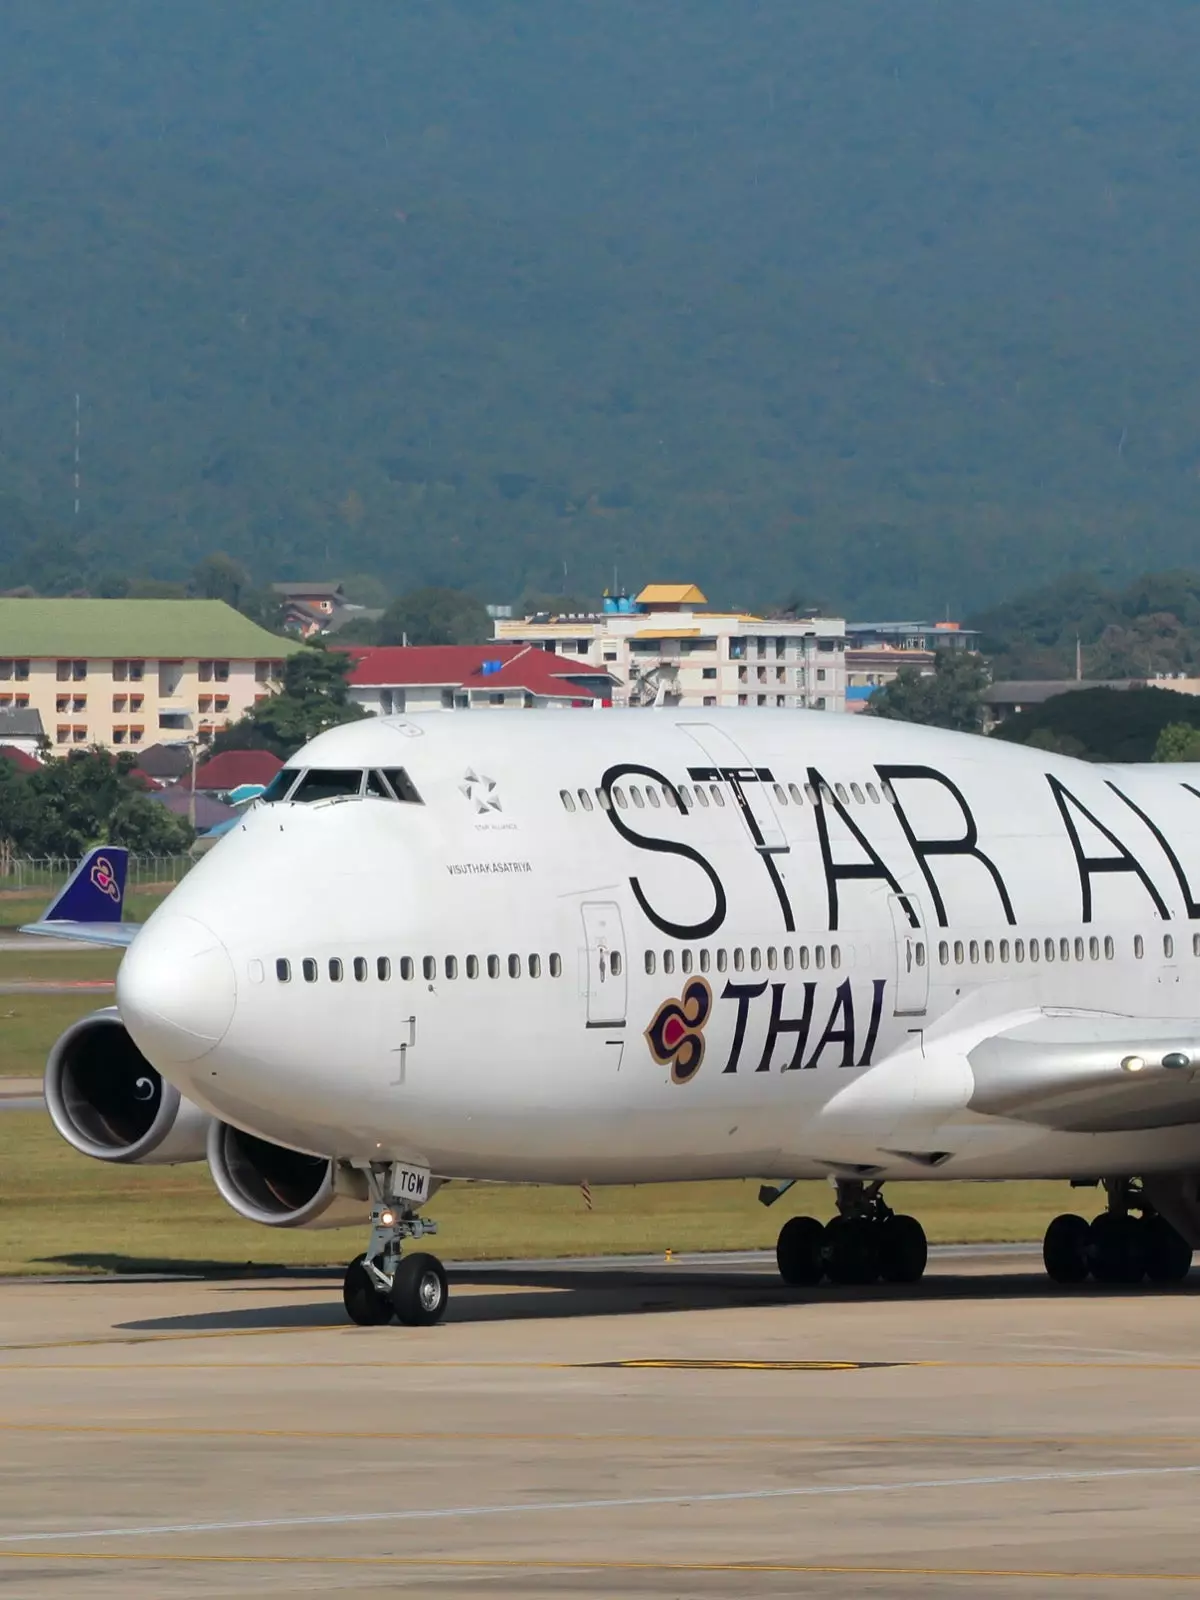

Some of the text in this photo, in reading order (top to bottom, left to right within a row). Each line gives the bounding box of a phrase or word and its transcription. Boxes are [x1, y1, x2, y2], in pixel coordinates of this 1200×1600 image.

[601, 763, 1017, 940] STAR
[720, 976, 887, 1074] THAI
[401, 1170, 425, 1195] TGW
